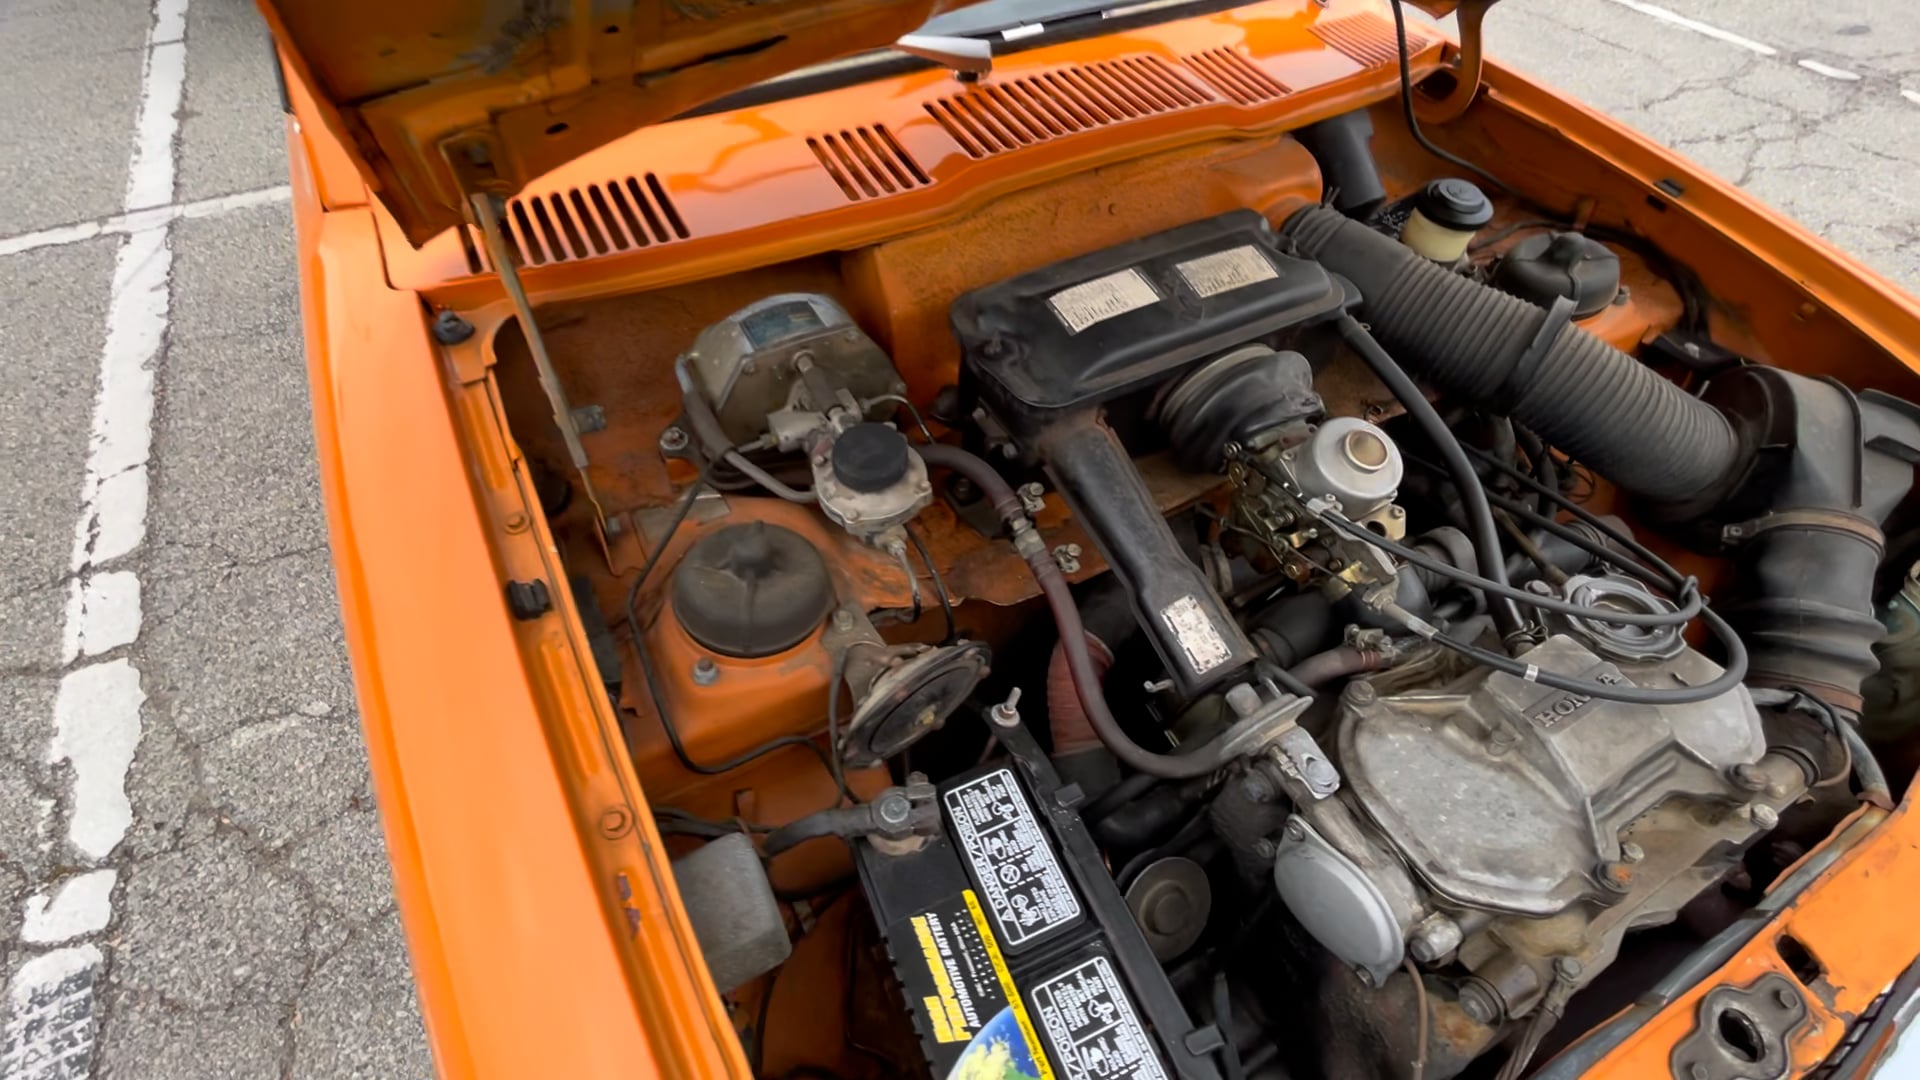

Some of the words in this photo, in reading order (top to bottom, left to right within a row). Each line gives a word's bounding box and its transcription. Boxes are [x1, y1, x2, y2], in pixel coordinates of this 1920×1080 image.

[1535, 673, 1622, 728] HONA
[952, 806, 1007, 909] DANGER/POISON
[925, 912, 953, 956] BATTERY
[944, 957, 982, 1027] AUTOMOTIVE
